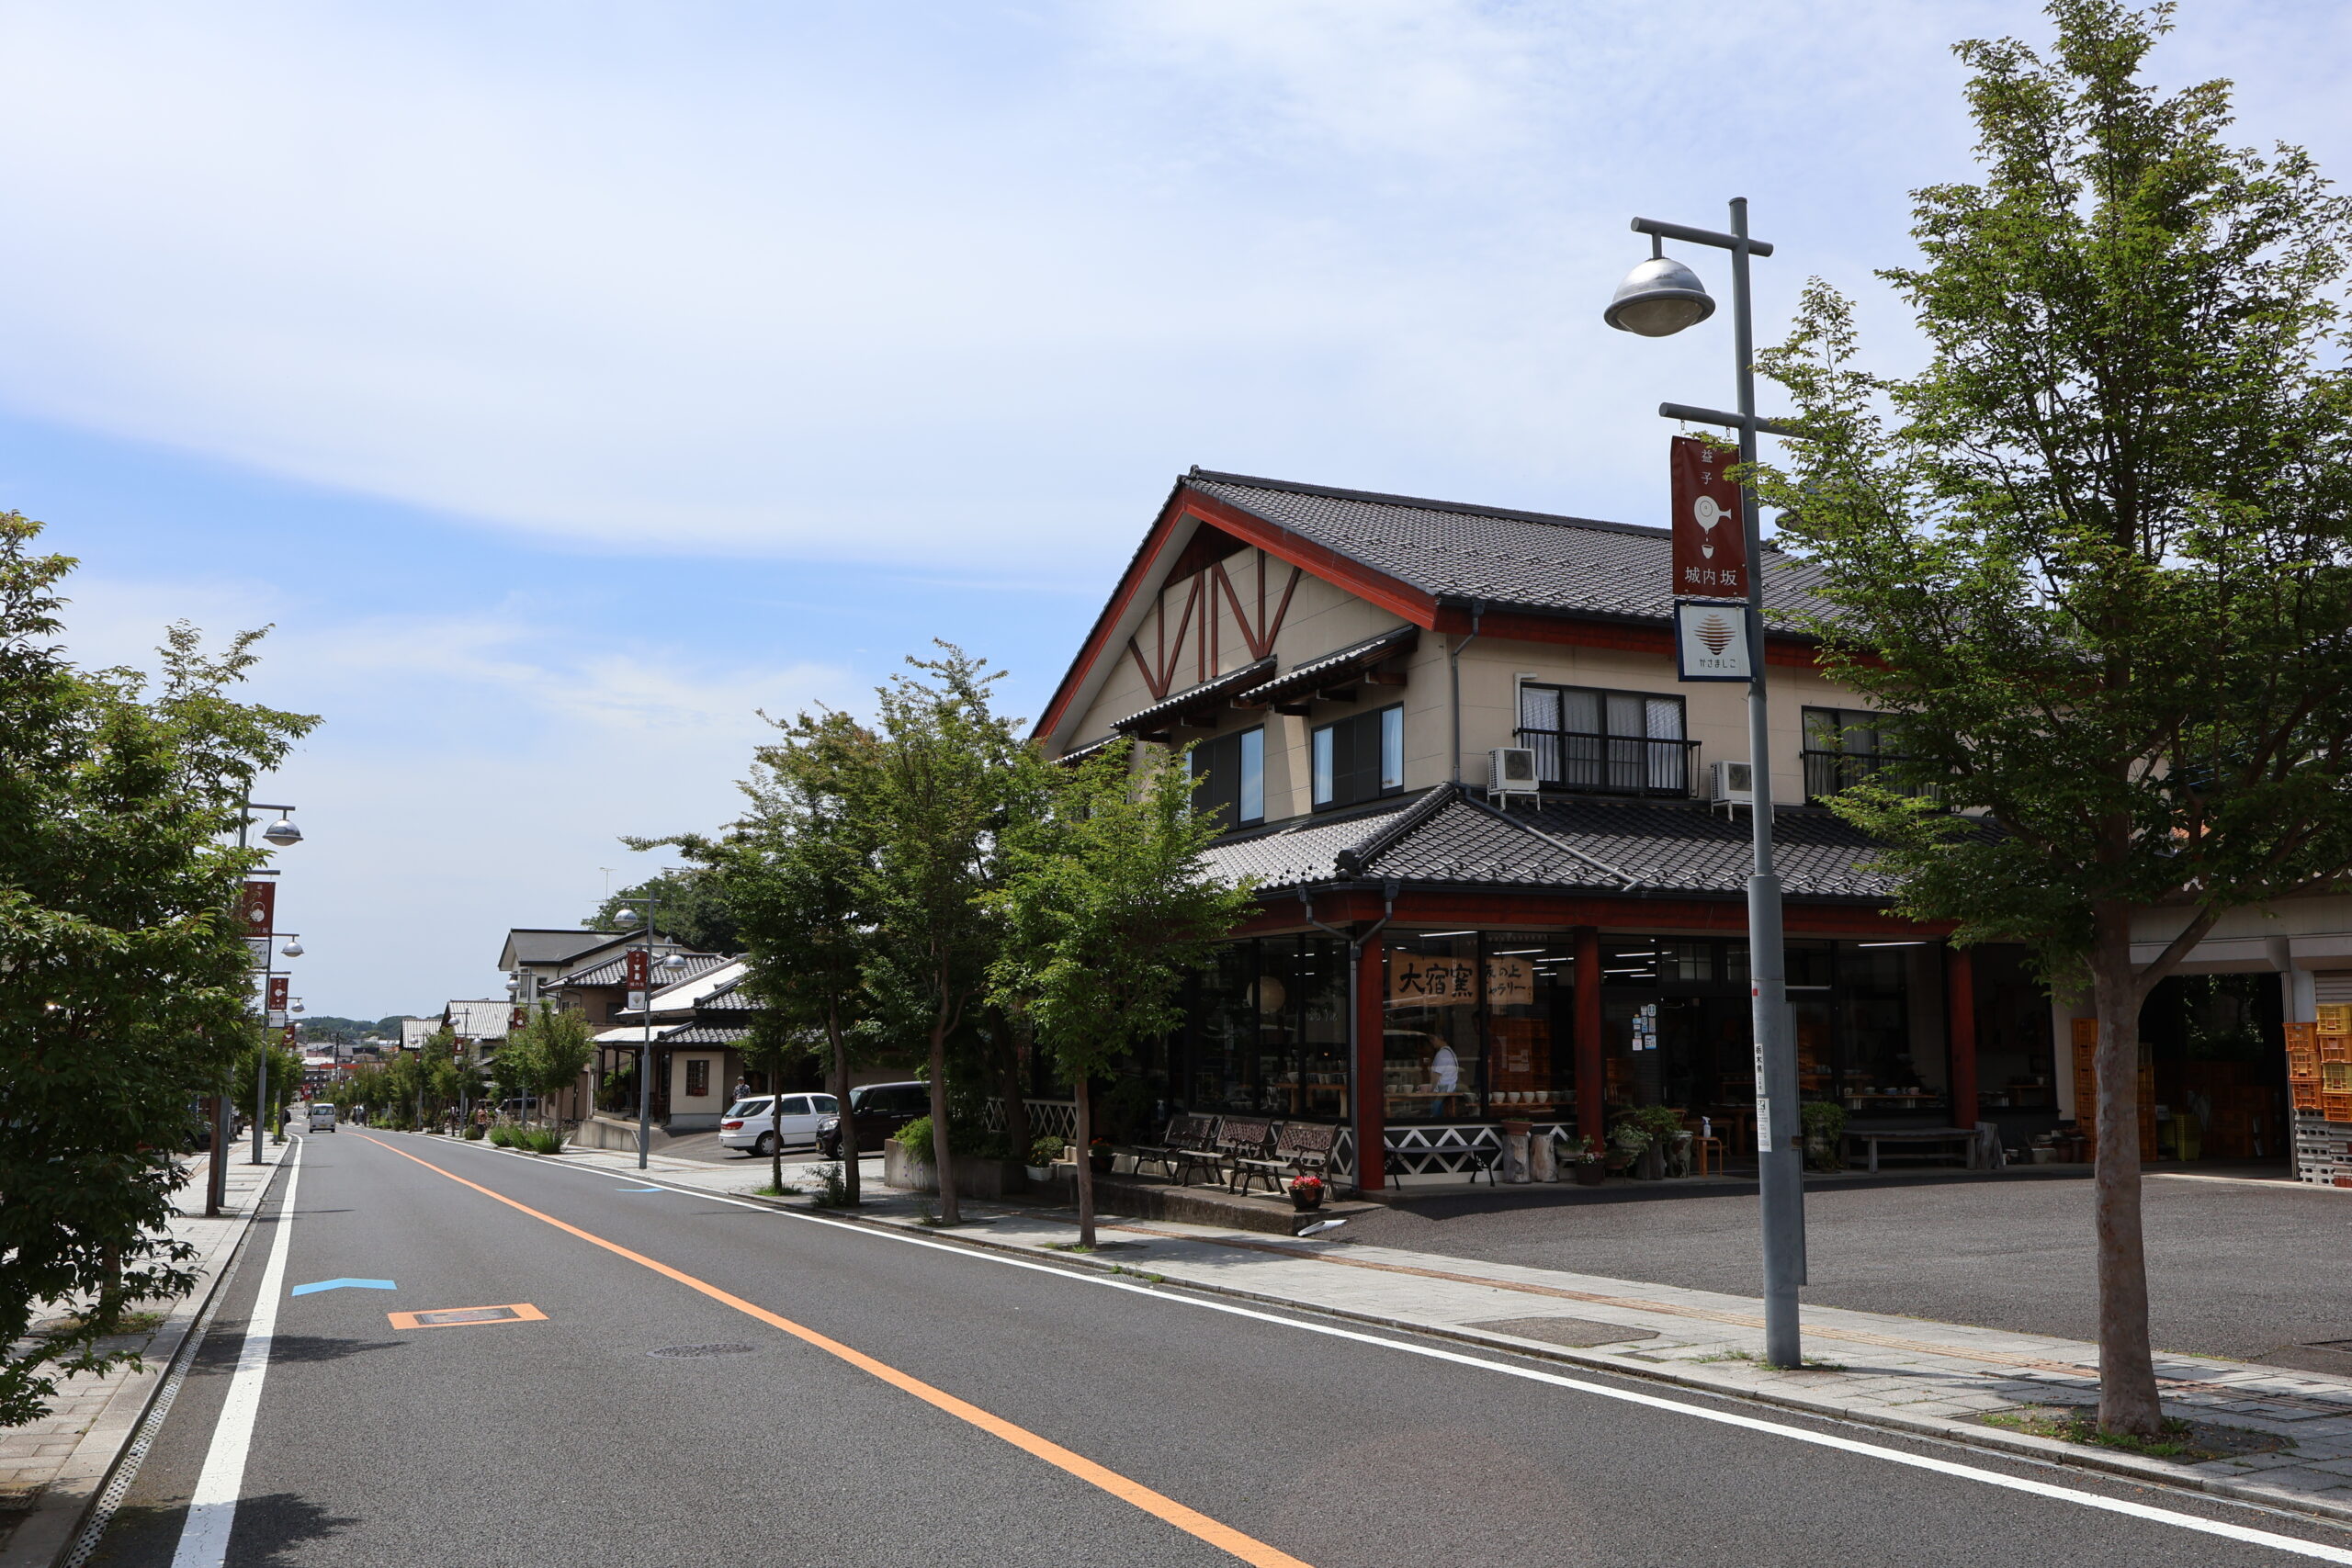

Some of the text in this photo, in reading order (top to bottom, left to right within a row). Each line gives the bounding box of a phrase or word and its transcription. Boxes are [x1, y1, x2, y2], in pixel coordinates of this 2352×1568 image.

[1701, 449, 1713, 485] 益子
[1684, 566, 1737, 586] 城内坂
[1397, 962, 1473, 998] 大宿窯
[1486, 981, 1526, 997] ャラリー
